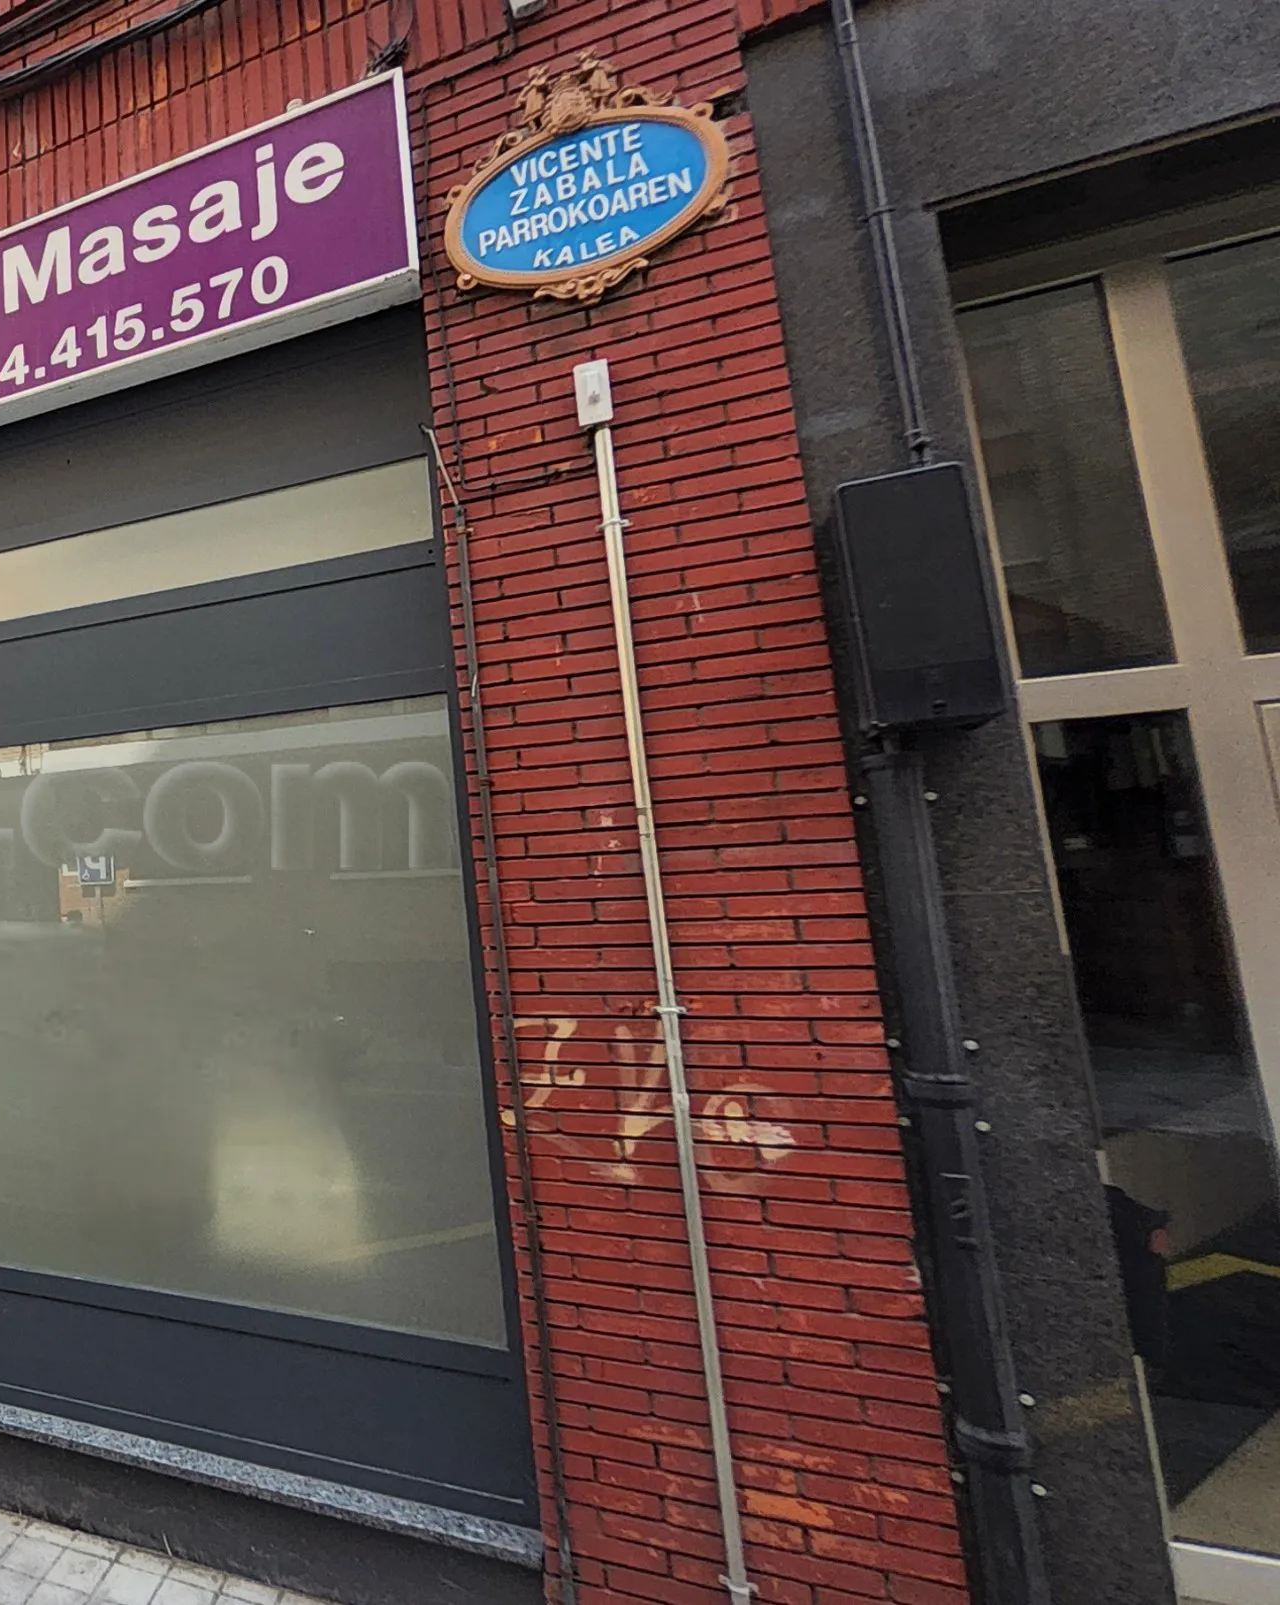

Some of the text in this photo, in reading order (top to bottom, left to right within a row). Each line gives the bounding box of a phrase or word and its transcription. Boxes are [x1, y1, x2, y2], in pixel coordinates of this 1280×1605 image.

[509, 123, 642, 188] VICENTE
[509, 151, 649, 217] ZABALA
[1, 141, 345, 315] Masaje
[478, 167, 694, 257] PARROKOAREN
[532, 225, 641, 269] KALEA
